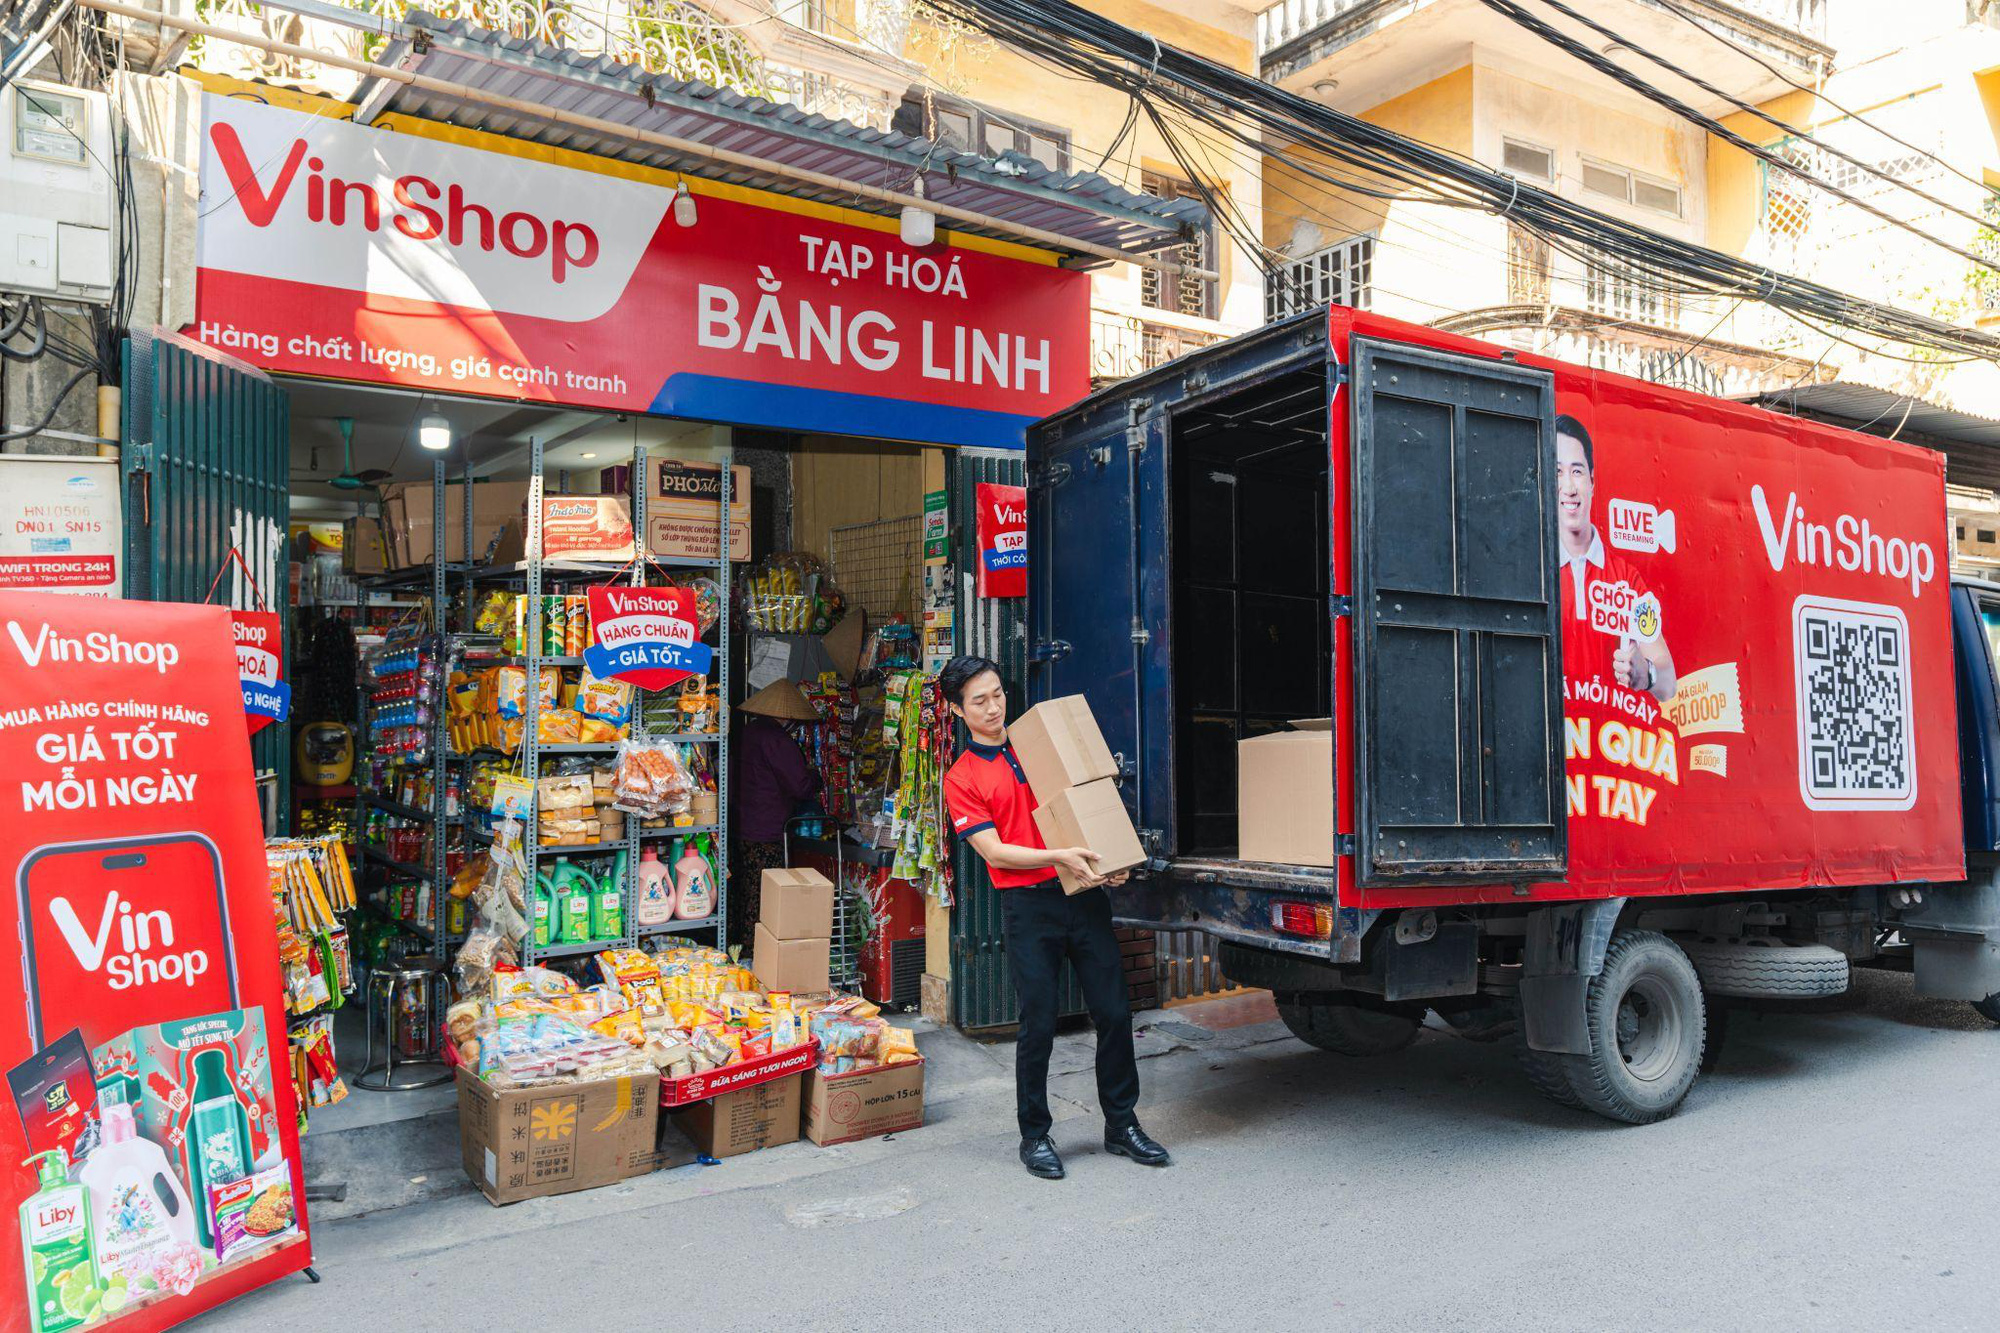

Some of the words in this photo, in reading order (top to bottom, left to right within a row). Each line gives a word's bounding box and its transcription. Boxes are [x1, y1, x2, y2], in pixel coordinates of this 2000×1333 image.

[210, 121, 600, 284] VinShop
[799, 234, 873, 287] TẠP
[885, 255, 969, 299] HOÁ
[697, 264, 900, 372] BẰNG
[921, 319, 1051, 394] LINH
[199, 320, 280, 358] Hàng
[287, 331, 353, 363] chất
[360, 343, 443, 378] lượng,
[450, 354, 492, 381] giá
[498, 362, 559, 388] cạnh
[565, 367, 628, 396] tranh
[64, 521, 102, 532] SN15
[1613, 507, 1654, 534] LIVE
[1003, 537, 1024, 550] TẠP
[1613, 531, 1655, 545] STREAMING
[1750, 484, 1936, 598] VinShop
[0, 563, 30, 573] WIFI
[32, 563, 82, 573] TRONG
[84, 562, 110, 572] 24H
[992, 554, 1011, 568] THỜI
[1012, 554, 1027, 565] CÔ
[59, 572, 85, 580] Camera
[607, 592, 679, 614] VinShop
[1592, 584, 1634, 611] CHỐT
[603, 623, 642, 643] HÀNG
[644, 621, 689, 639] CHUẨN
[1595, 608, 1629, 632] ĐƠN
[8, 620, 179, 674] VinShop
[232, 621, 266, 647] Shop
[237, 655, 267, 678] HOÁ
[619, 645, 649, 664] GIÁ
[650, 643, 682, 663] TỐT
[254, 692, 282, 716] NGHỆ
[1575, 674, 1608, 704] MỖI
[1612, 688, 1658, 725] NGÀY
[0, 709, 42, 728] MUA
[46, 700, 100, 721] HÀNG
[105, 698, 157, 720] CHÍNH
[162, 701, 209, 728] HÃNG
[36, 724, 105, 764] GIÁ
[111, 722, 178, 761] TỐT
[1598, 720, 1679, 785] QUÀ
[21, 767, 97, 813] MỖI
[107, 767, 198, 807] NGÀY
[1592, 775, 1657, 826] TAY
[49, 890, 175, 972] Vin
[106, 947, 208, 990] Shop
[731, 1069, 757, 1083] SÁNG
[896, 1088, 908, 1100] 15
[39, 1204, 76, 1228] Liby
[100, 1252, 121, 1265] Liby
